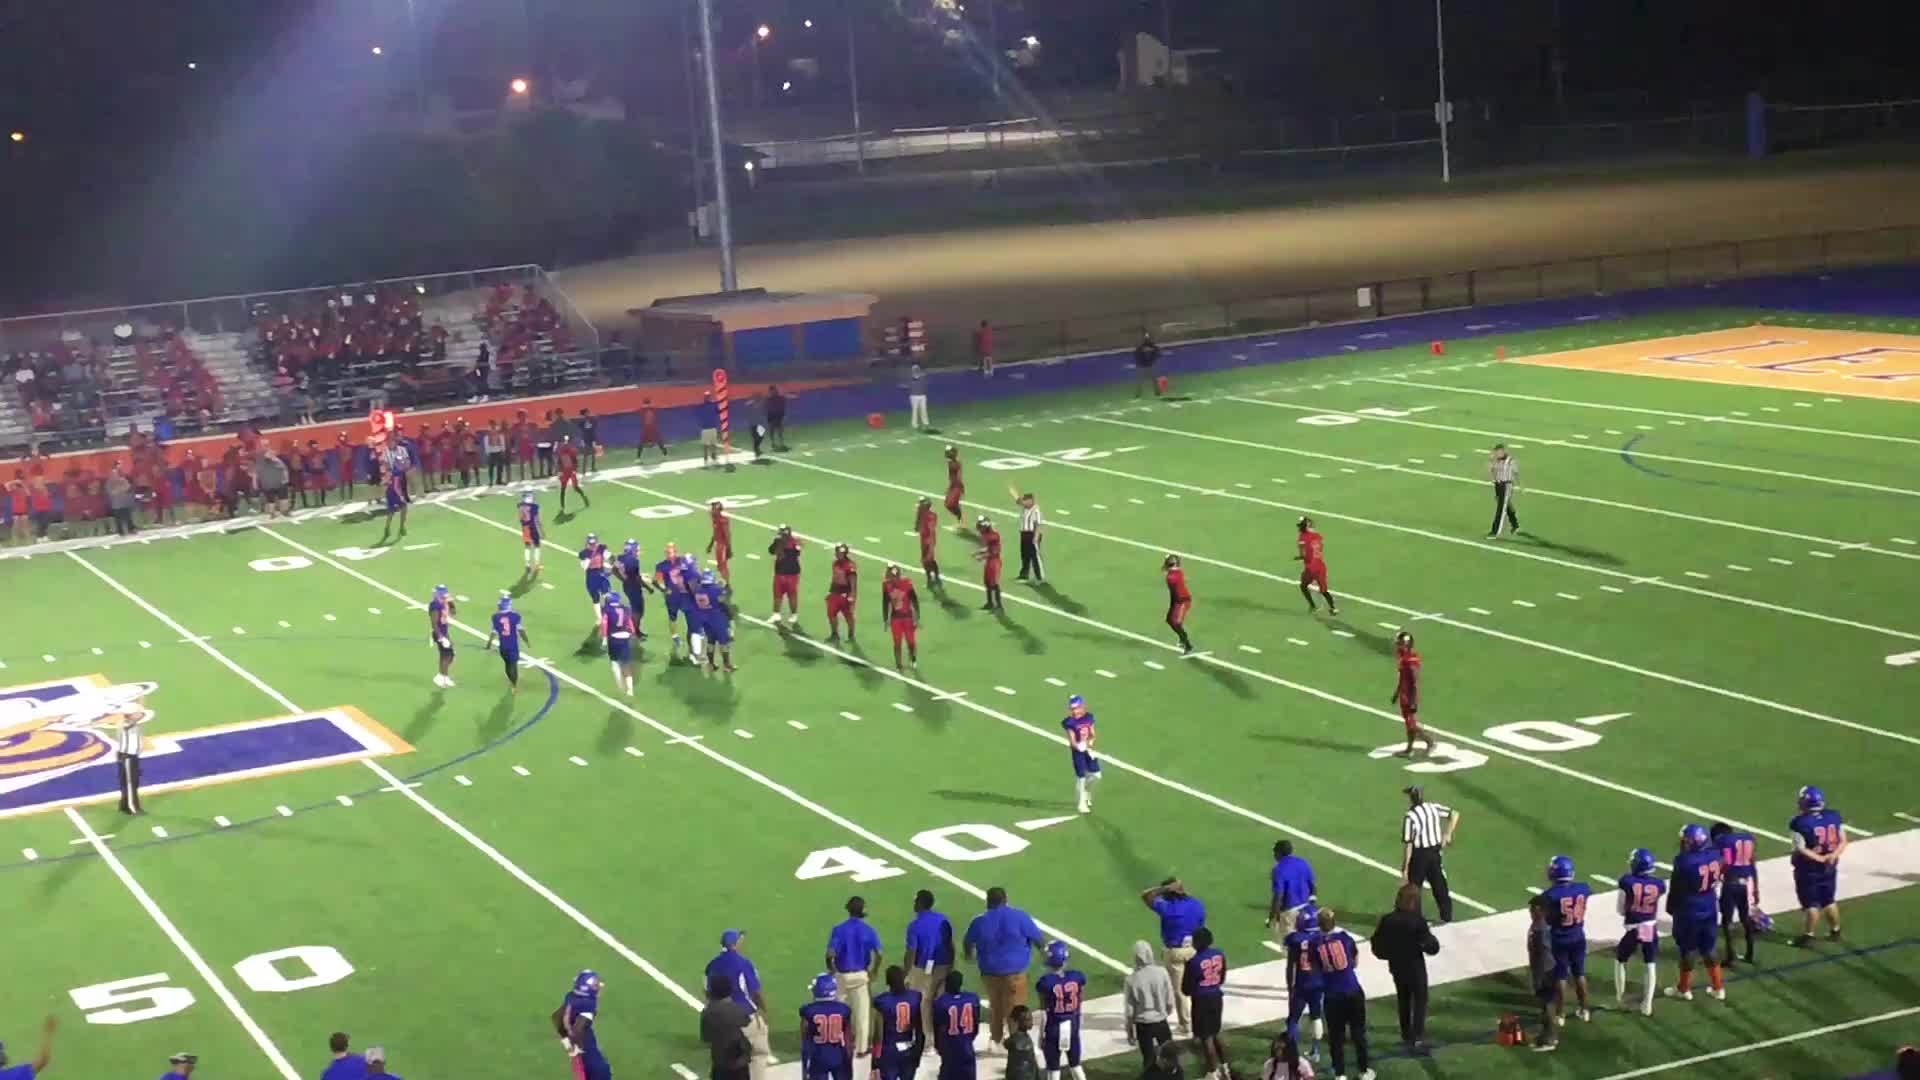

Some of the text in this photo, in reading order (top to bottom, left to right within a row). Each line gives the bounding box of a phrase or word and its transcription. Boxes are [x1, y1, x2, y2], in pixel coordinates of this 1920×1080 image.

[1368, 721, 1603, 773] 30
[795, 824, 1032, 882] 40
[1560, 893, 1586, 927] 54
[1632, 882, 1660, 914] 12
[68, 946, 356, 1025] 50
[1053, 980, 1080, 1015] 13
[948, 1002, 974, 1035] 14
